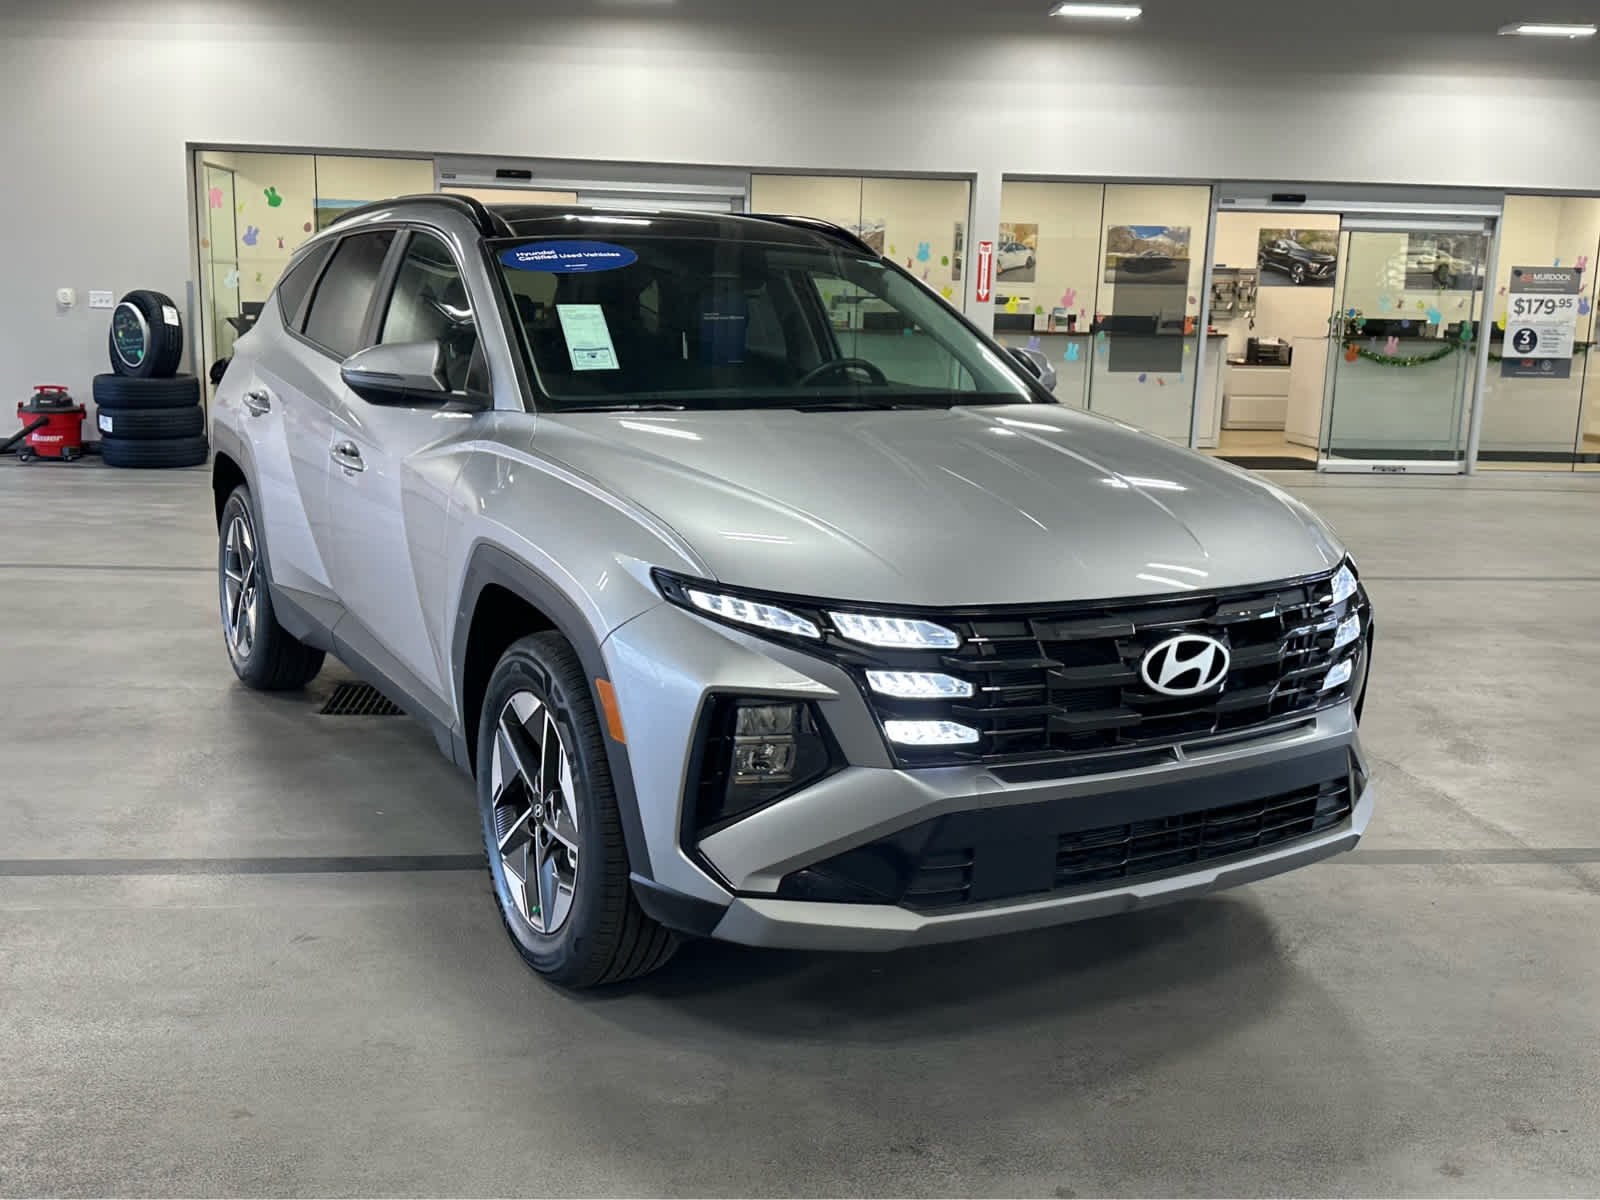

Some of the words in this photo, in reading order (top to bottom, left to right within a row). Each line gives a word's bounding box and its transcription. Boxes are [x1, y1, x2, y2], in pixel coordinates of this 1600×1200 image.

[515, 249, 555, 257] Hyundai
[518, 254, 558, 262] Certified
[1533, 273, 1571, 281] MURDOCK
[1520, 330, 1531, 344] 3
